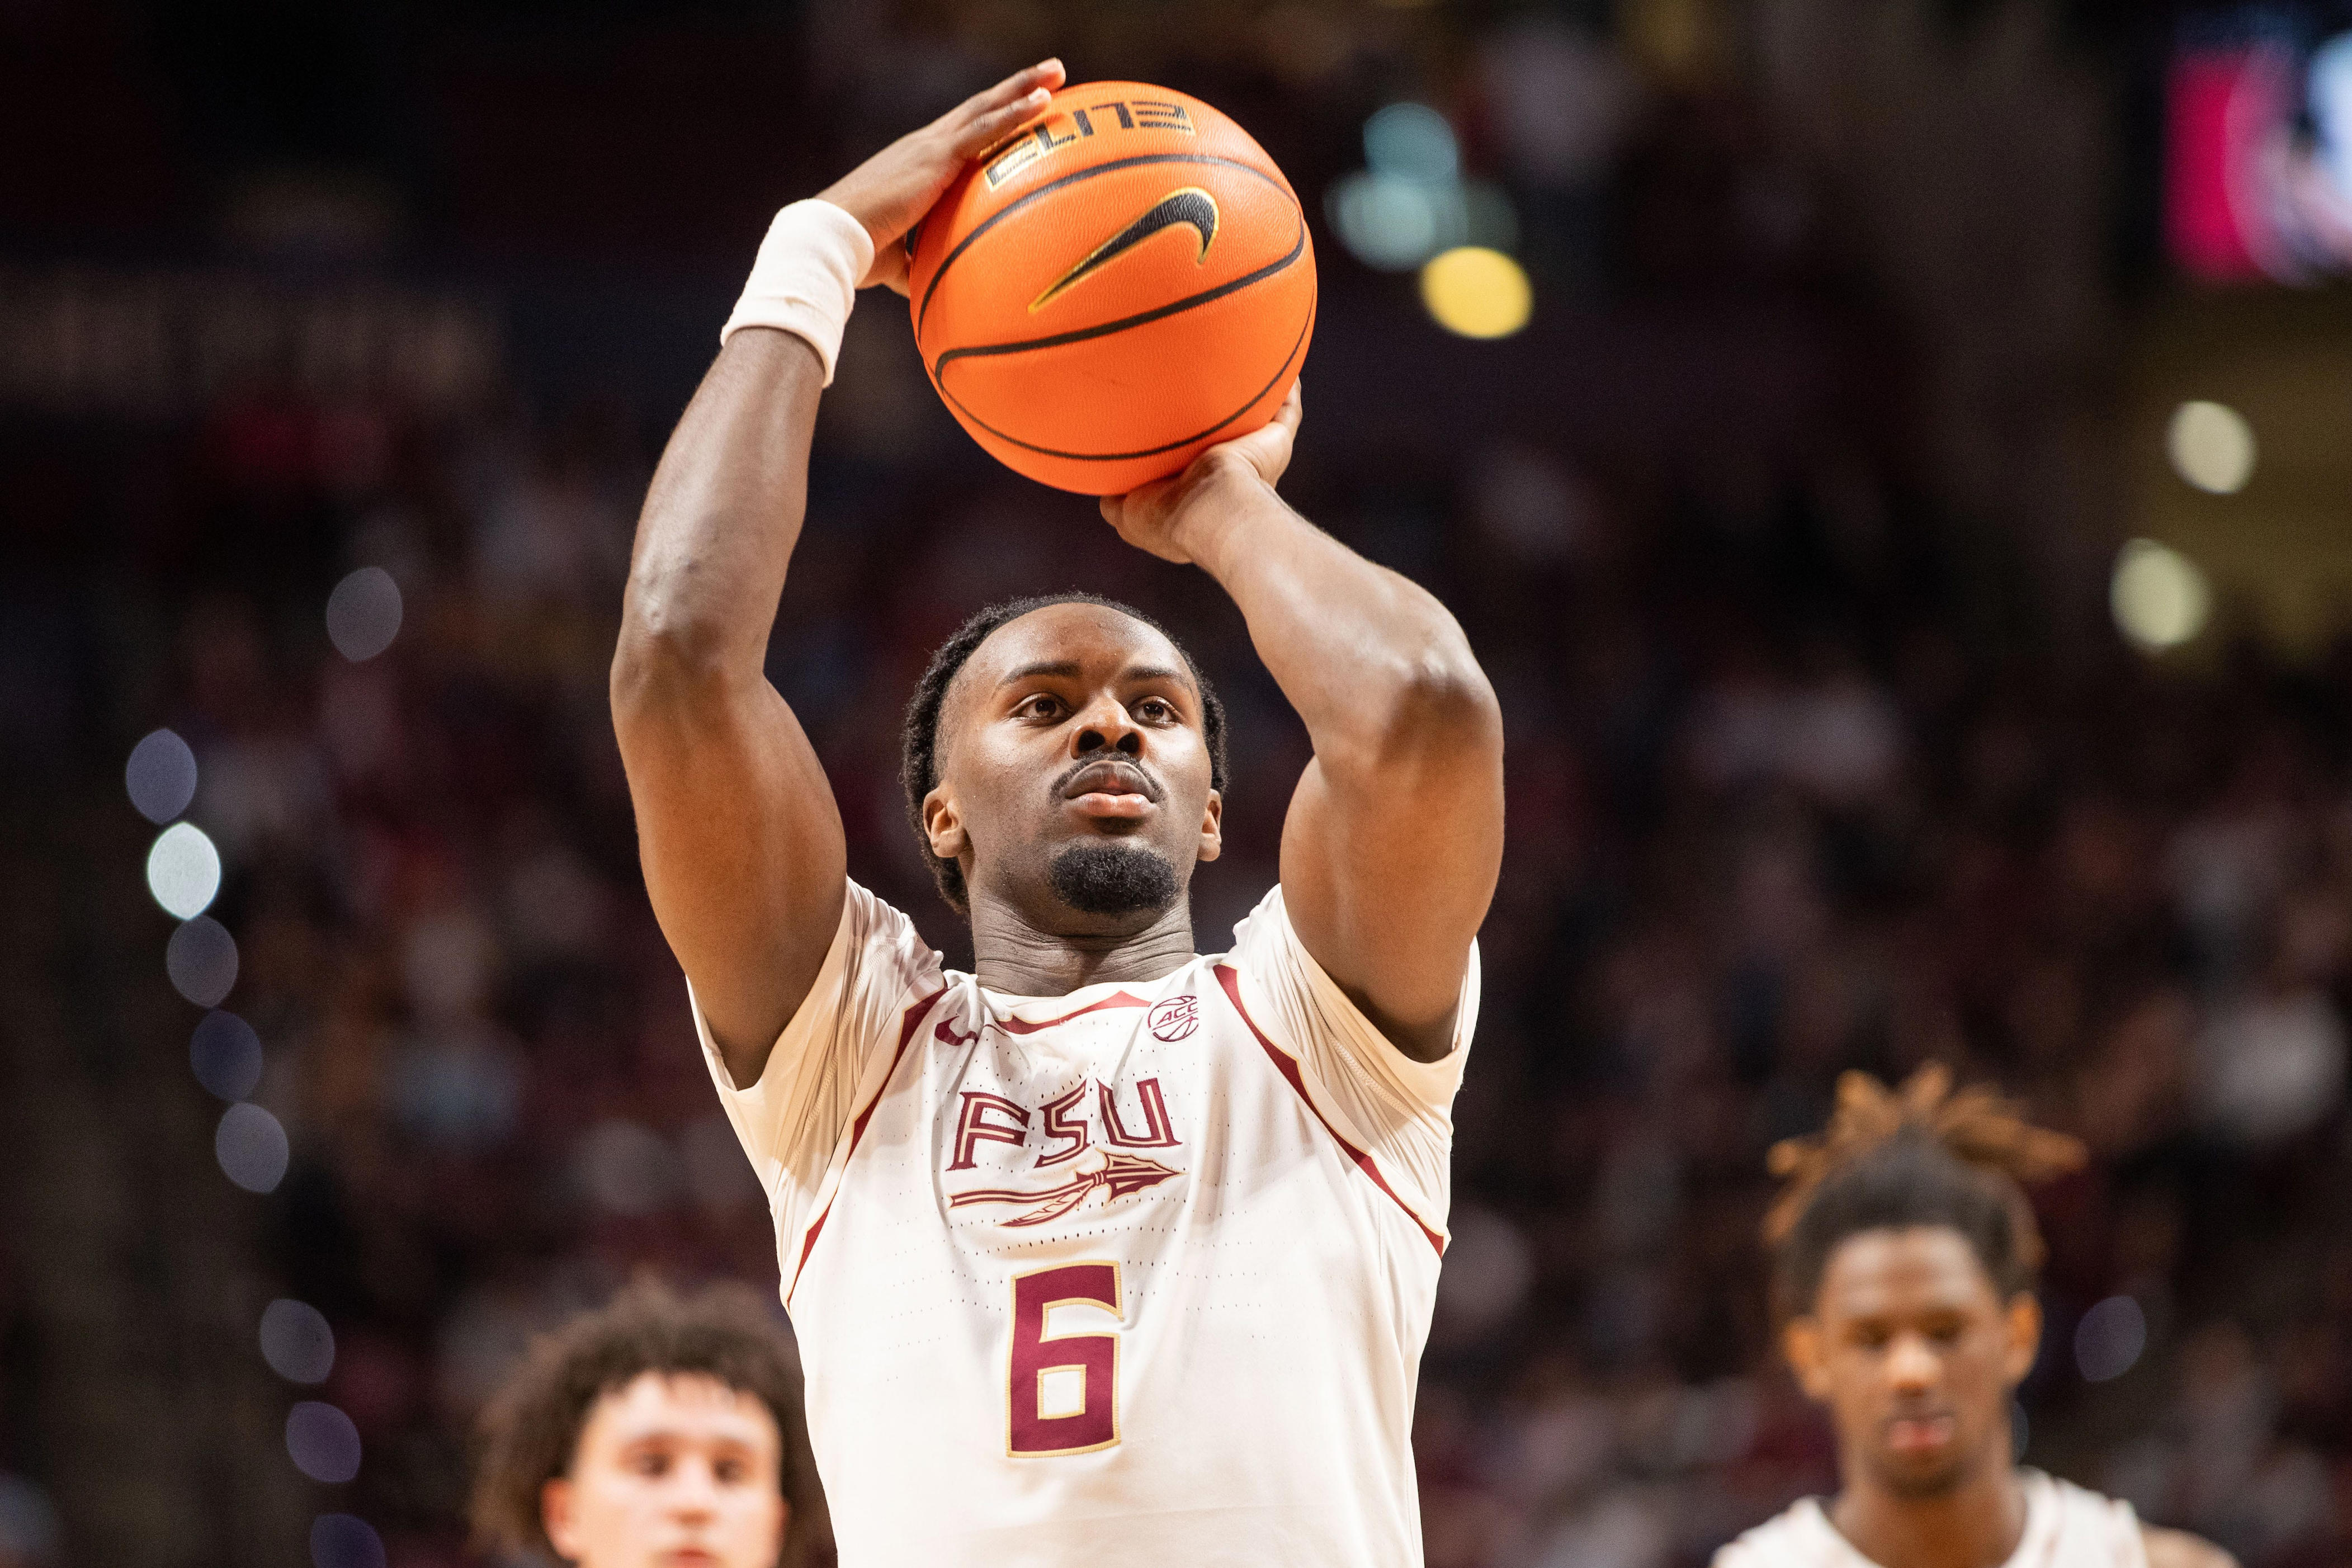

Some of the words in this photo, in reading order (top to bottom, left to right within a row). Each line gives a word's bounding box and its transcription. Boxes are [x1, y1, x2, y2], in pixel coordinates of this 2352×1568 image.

[981, 101, 1194, 189] ELITE
[1156, 1002, 1198, 1026] ACC
[946, 1078, 1183, 1171] FSU
[1005, 1259, 1123, 1458] 6
